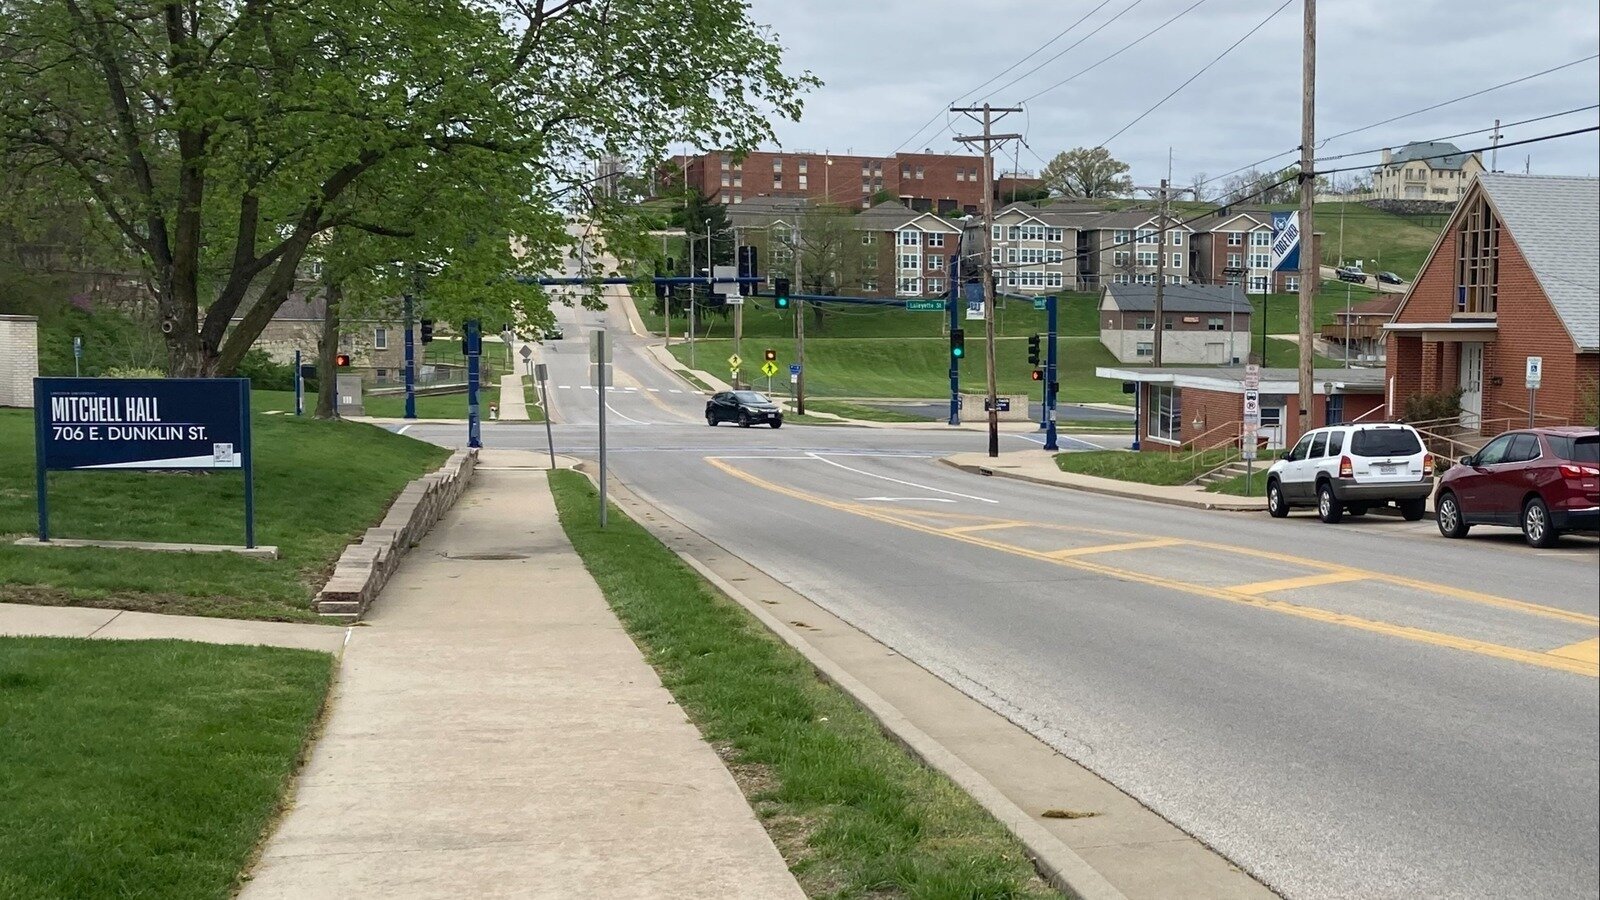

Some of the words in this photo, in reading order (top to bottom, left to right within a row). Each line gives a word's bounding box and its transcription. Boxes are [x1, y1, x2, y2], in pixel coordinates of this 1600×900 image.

[1273, 224, 1299, 257] TOGETHER
[51, 397, 122, 422] MITCHELL
[126, 397, 161, 422] HALL
[53, 426, 84, 441] 706
[89, 427, 103, 440] E.
[108, 426, 183, 440] DUNKLIN
[188, 426, 208, 440] ST.
